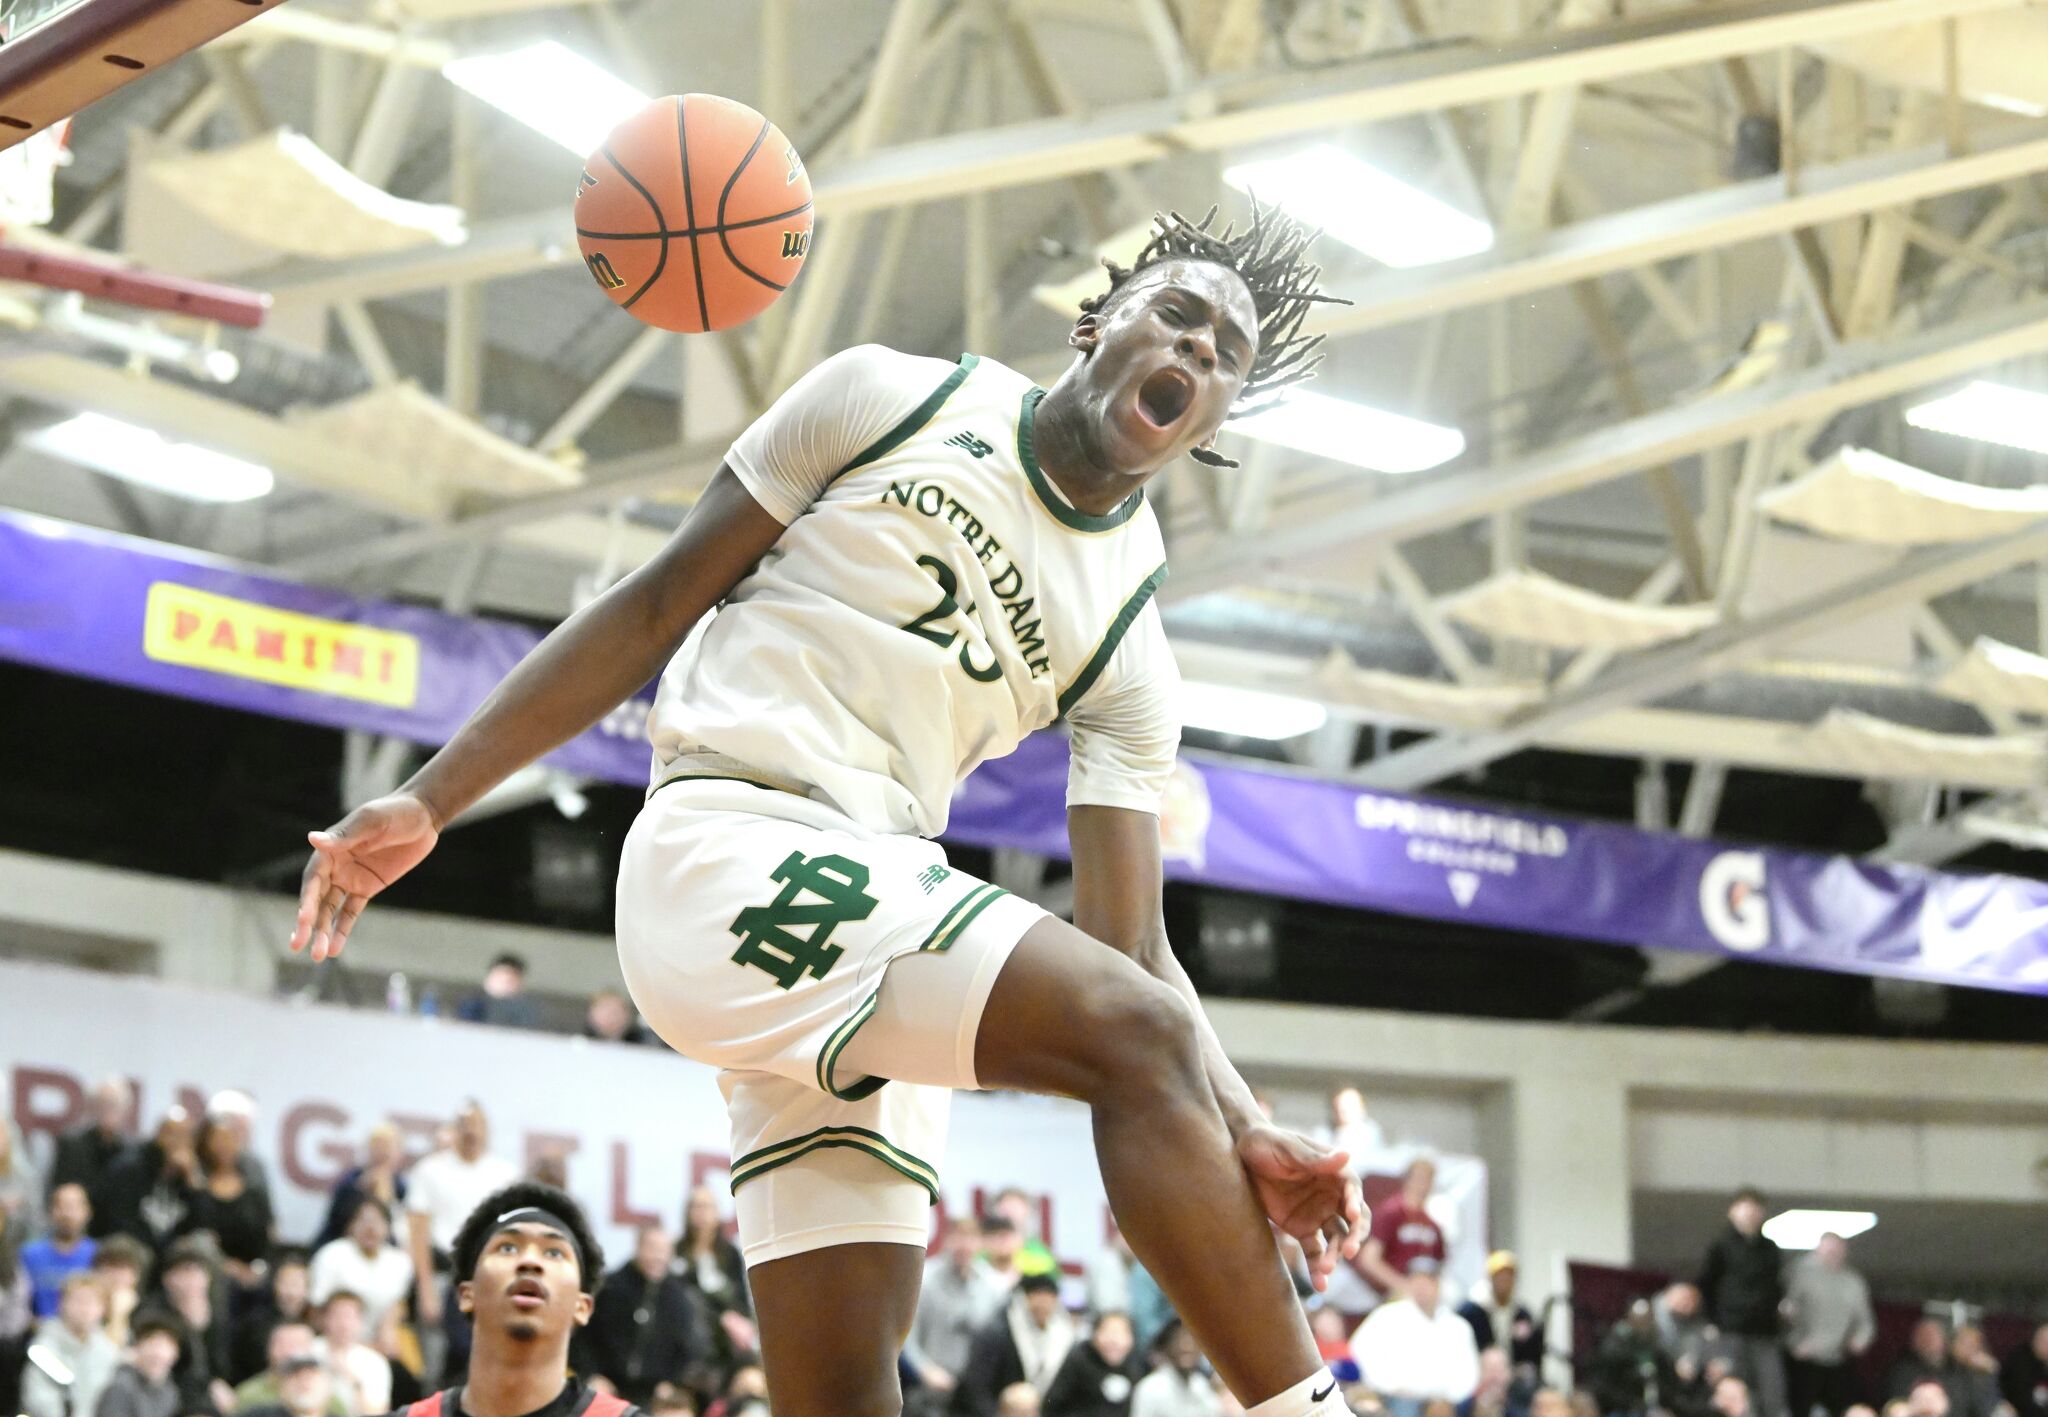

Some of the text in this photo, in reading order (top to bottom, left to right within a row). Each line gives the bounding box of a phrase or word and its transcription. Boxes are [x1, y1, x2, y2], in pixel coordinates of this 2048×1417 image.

[881, 481, 1051, 680] NOTRE DAME
[172, 609, 395, 684] PANINI
[1354, 793, 1569, 858] SPRINGFIELD
[1698, 850, 1771, 953] G
